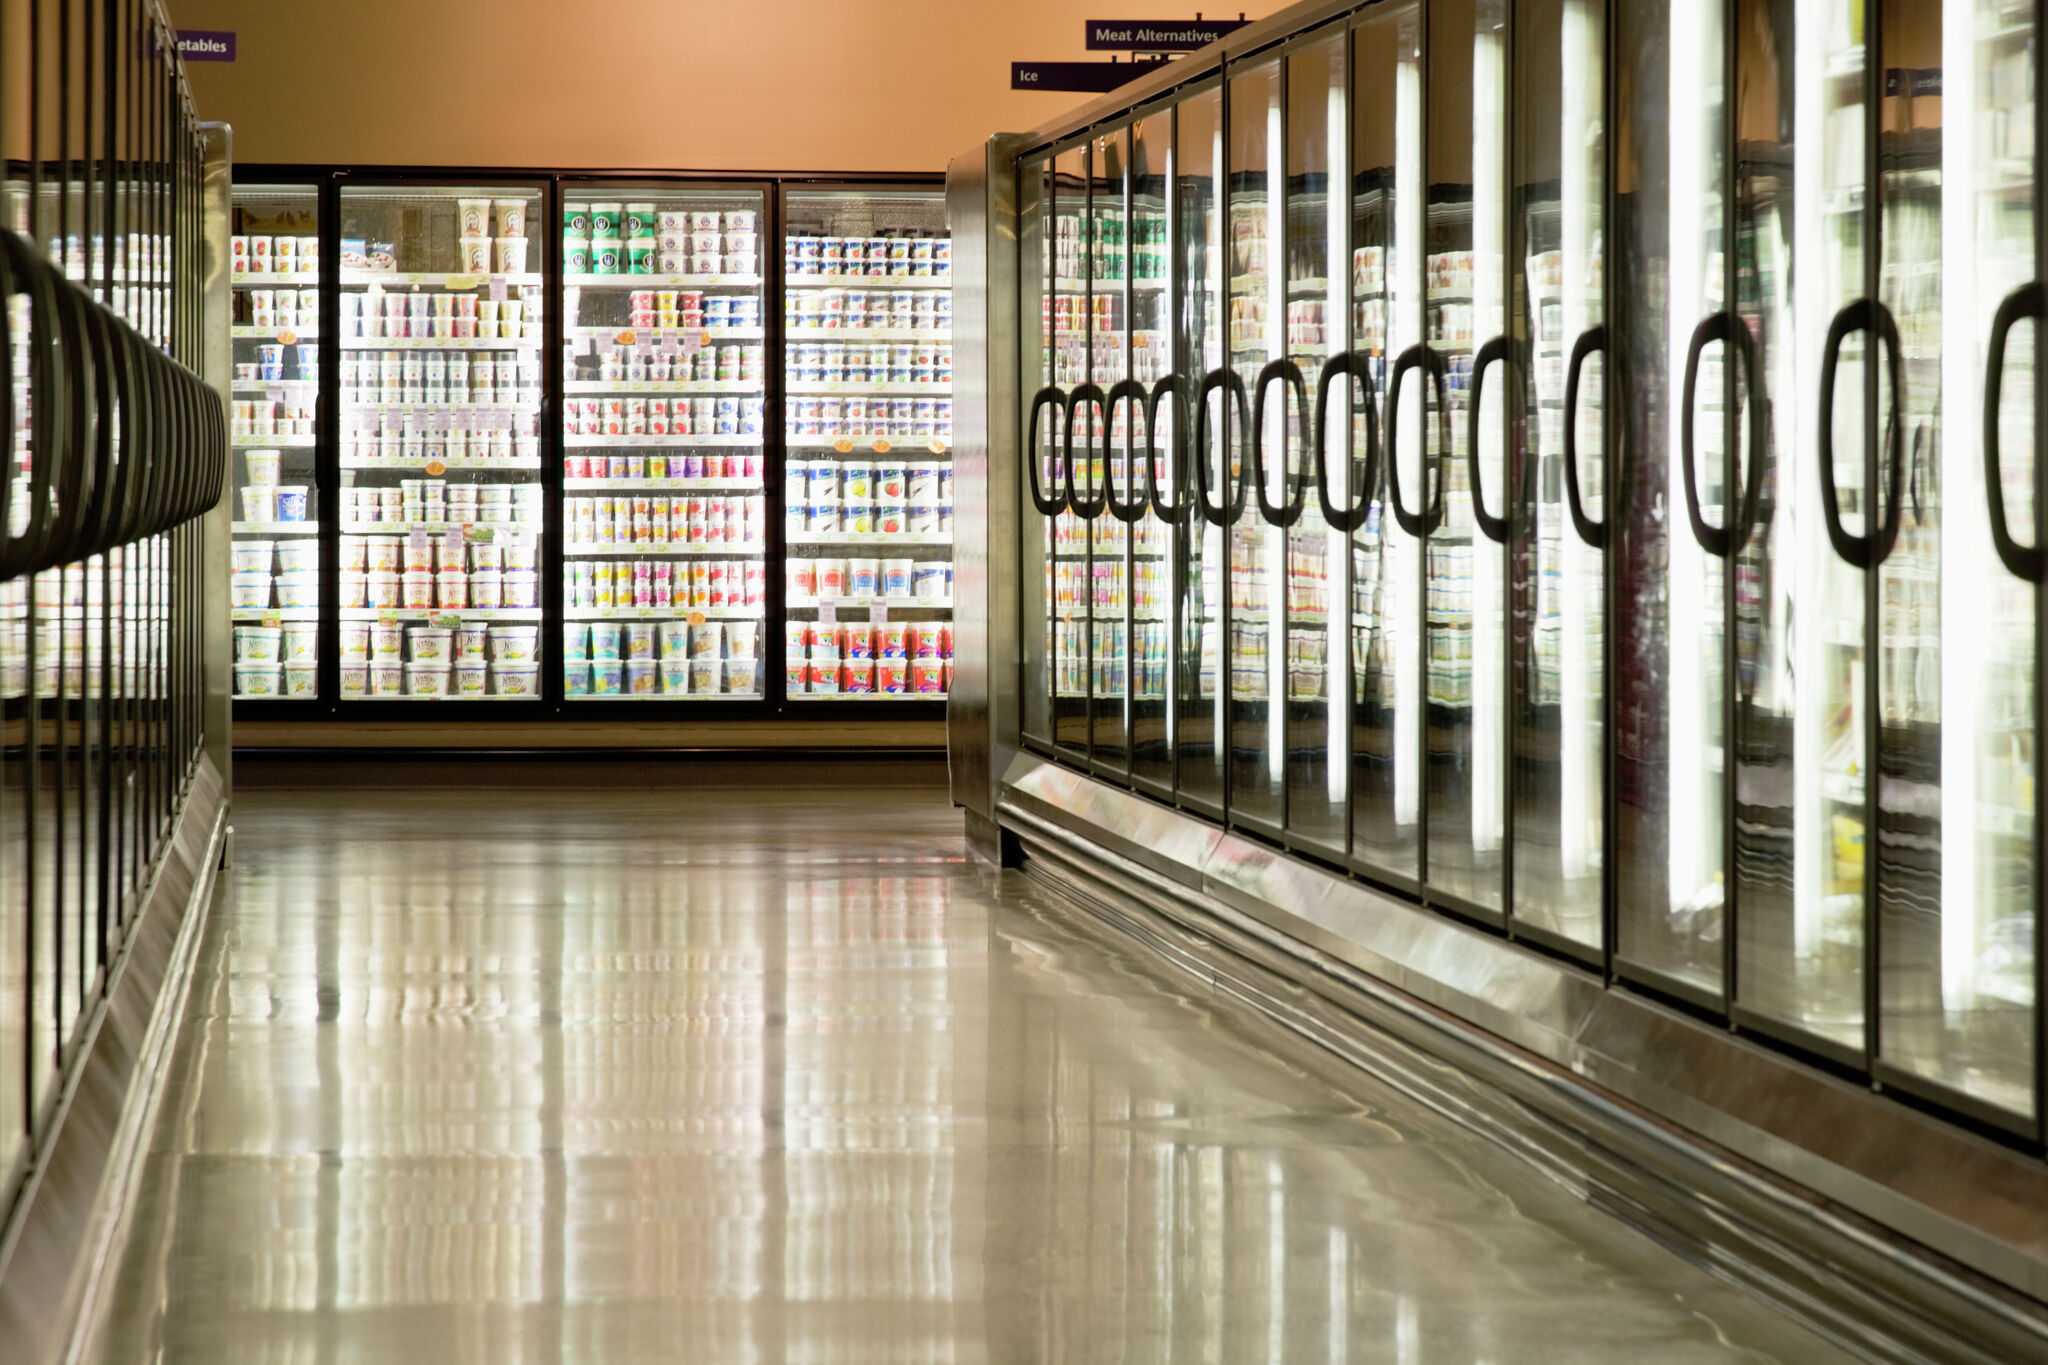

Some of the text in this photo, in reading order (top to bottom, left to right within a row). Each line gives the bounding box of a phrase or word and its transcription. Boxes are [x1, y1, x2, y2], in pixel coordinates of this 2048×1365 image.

[1096, 28, 1219, 42] Meat Alternatives
[178, 39, 227, 52] etables
[1020, 69, 1038, 82] Ice
